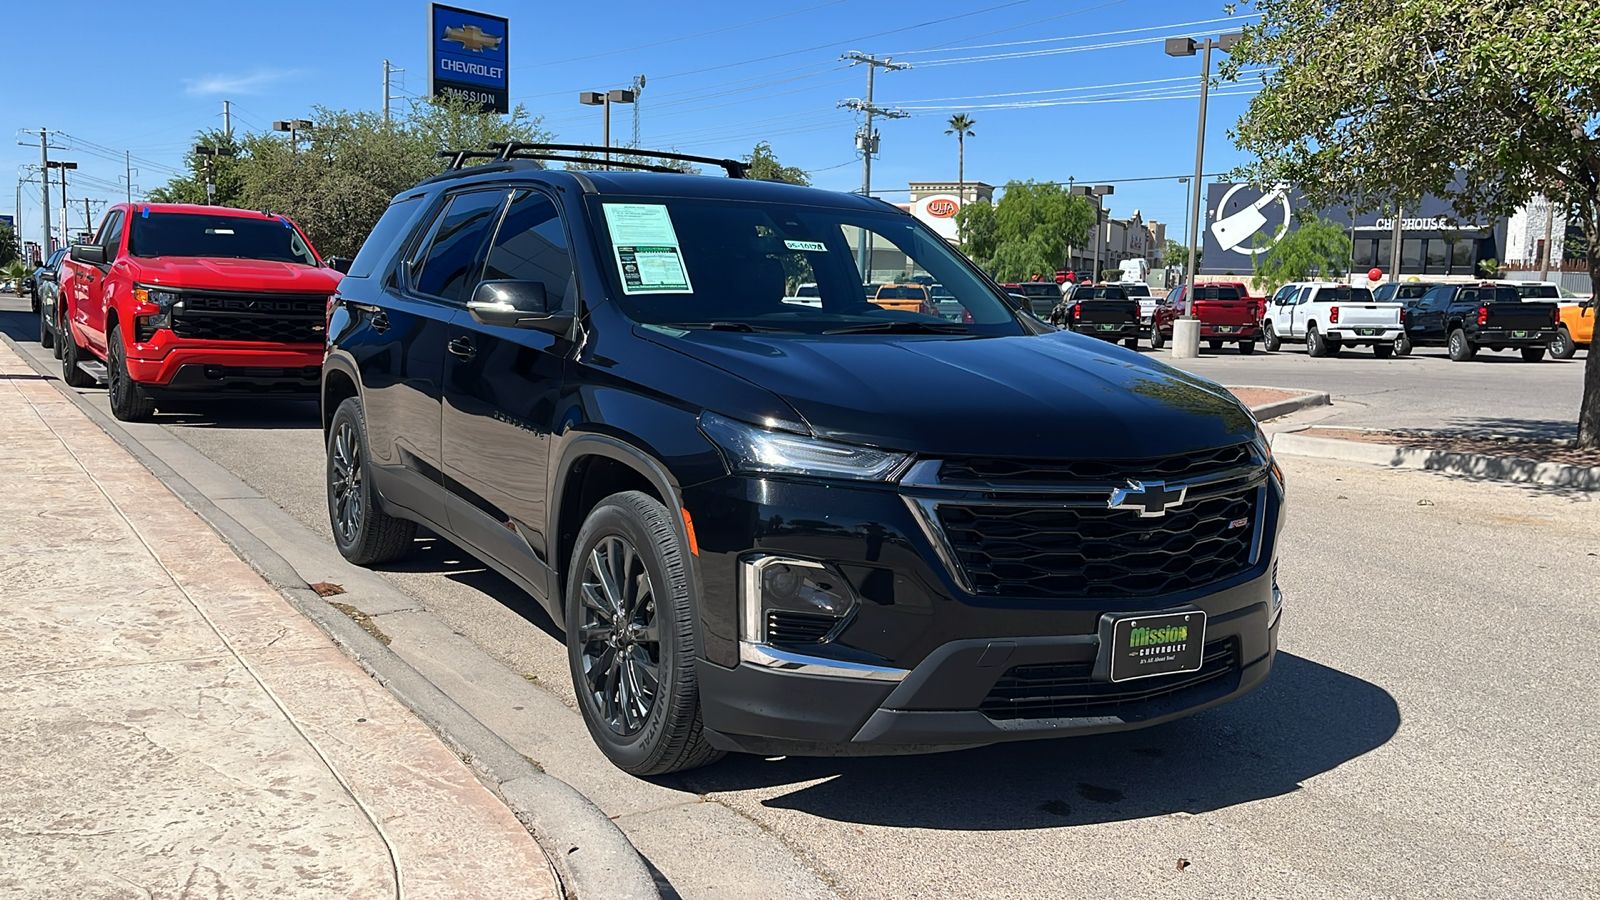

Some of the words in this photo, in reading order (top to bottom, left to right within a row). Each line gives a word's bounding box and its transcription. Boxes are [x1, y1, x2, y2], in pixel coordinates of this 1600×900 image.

[441, 58, 503, 78] CHEVROLET
[931, 202, 954, 211] ULTA
[187, 297, 326, 312] CHEVROLE
[1228, 517, 1248, 529] RS
[1129, 625, 1188, 647] Mission
[1139, 644, 1187, 656] CHEVROLET
[639, 620, 669, 751] NTINENTAL
